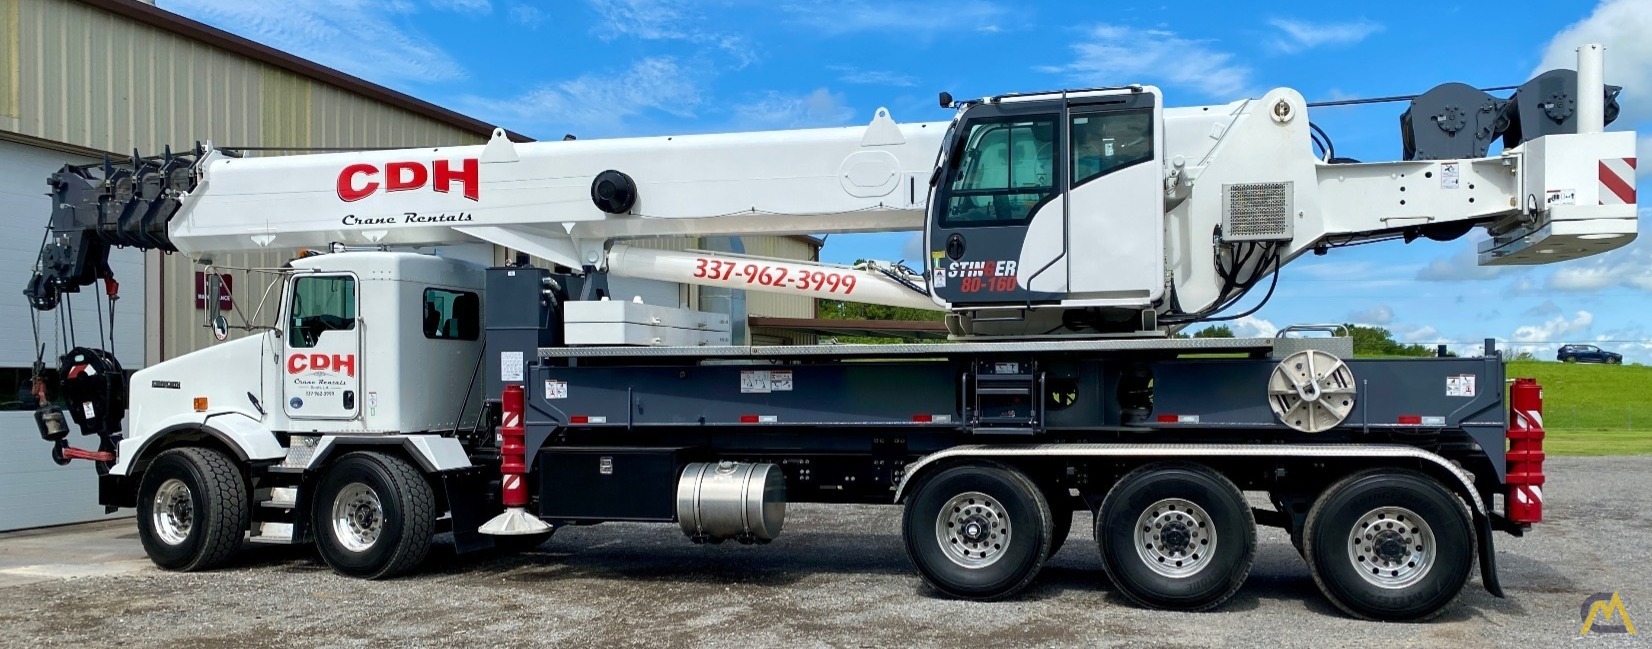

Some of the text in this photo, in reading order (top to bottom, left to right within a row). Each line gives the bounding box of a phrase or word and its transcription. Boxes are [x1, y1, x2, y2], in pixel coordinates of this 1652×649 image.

[337, 158, 479, 202] CDH
[342, 212, 474, 225] Crane Rentals
[693, 258, 857, 295] 337-962-3999
[948, 260, 1017, 278] STINGER
[961, 276, 1018, 293] 80-160
[287, 353, 355, 378] CDH
